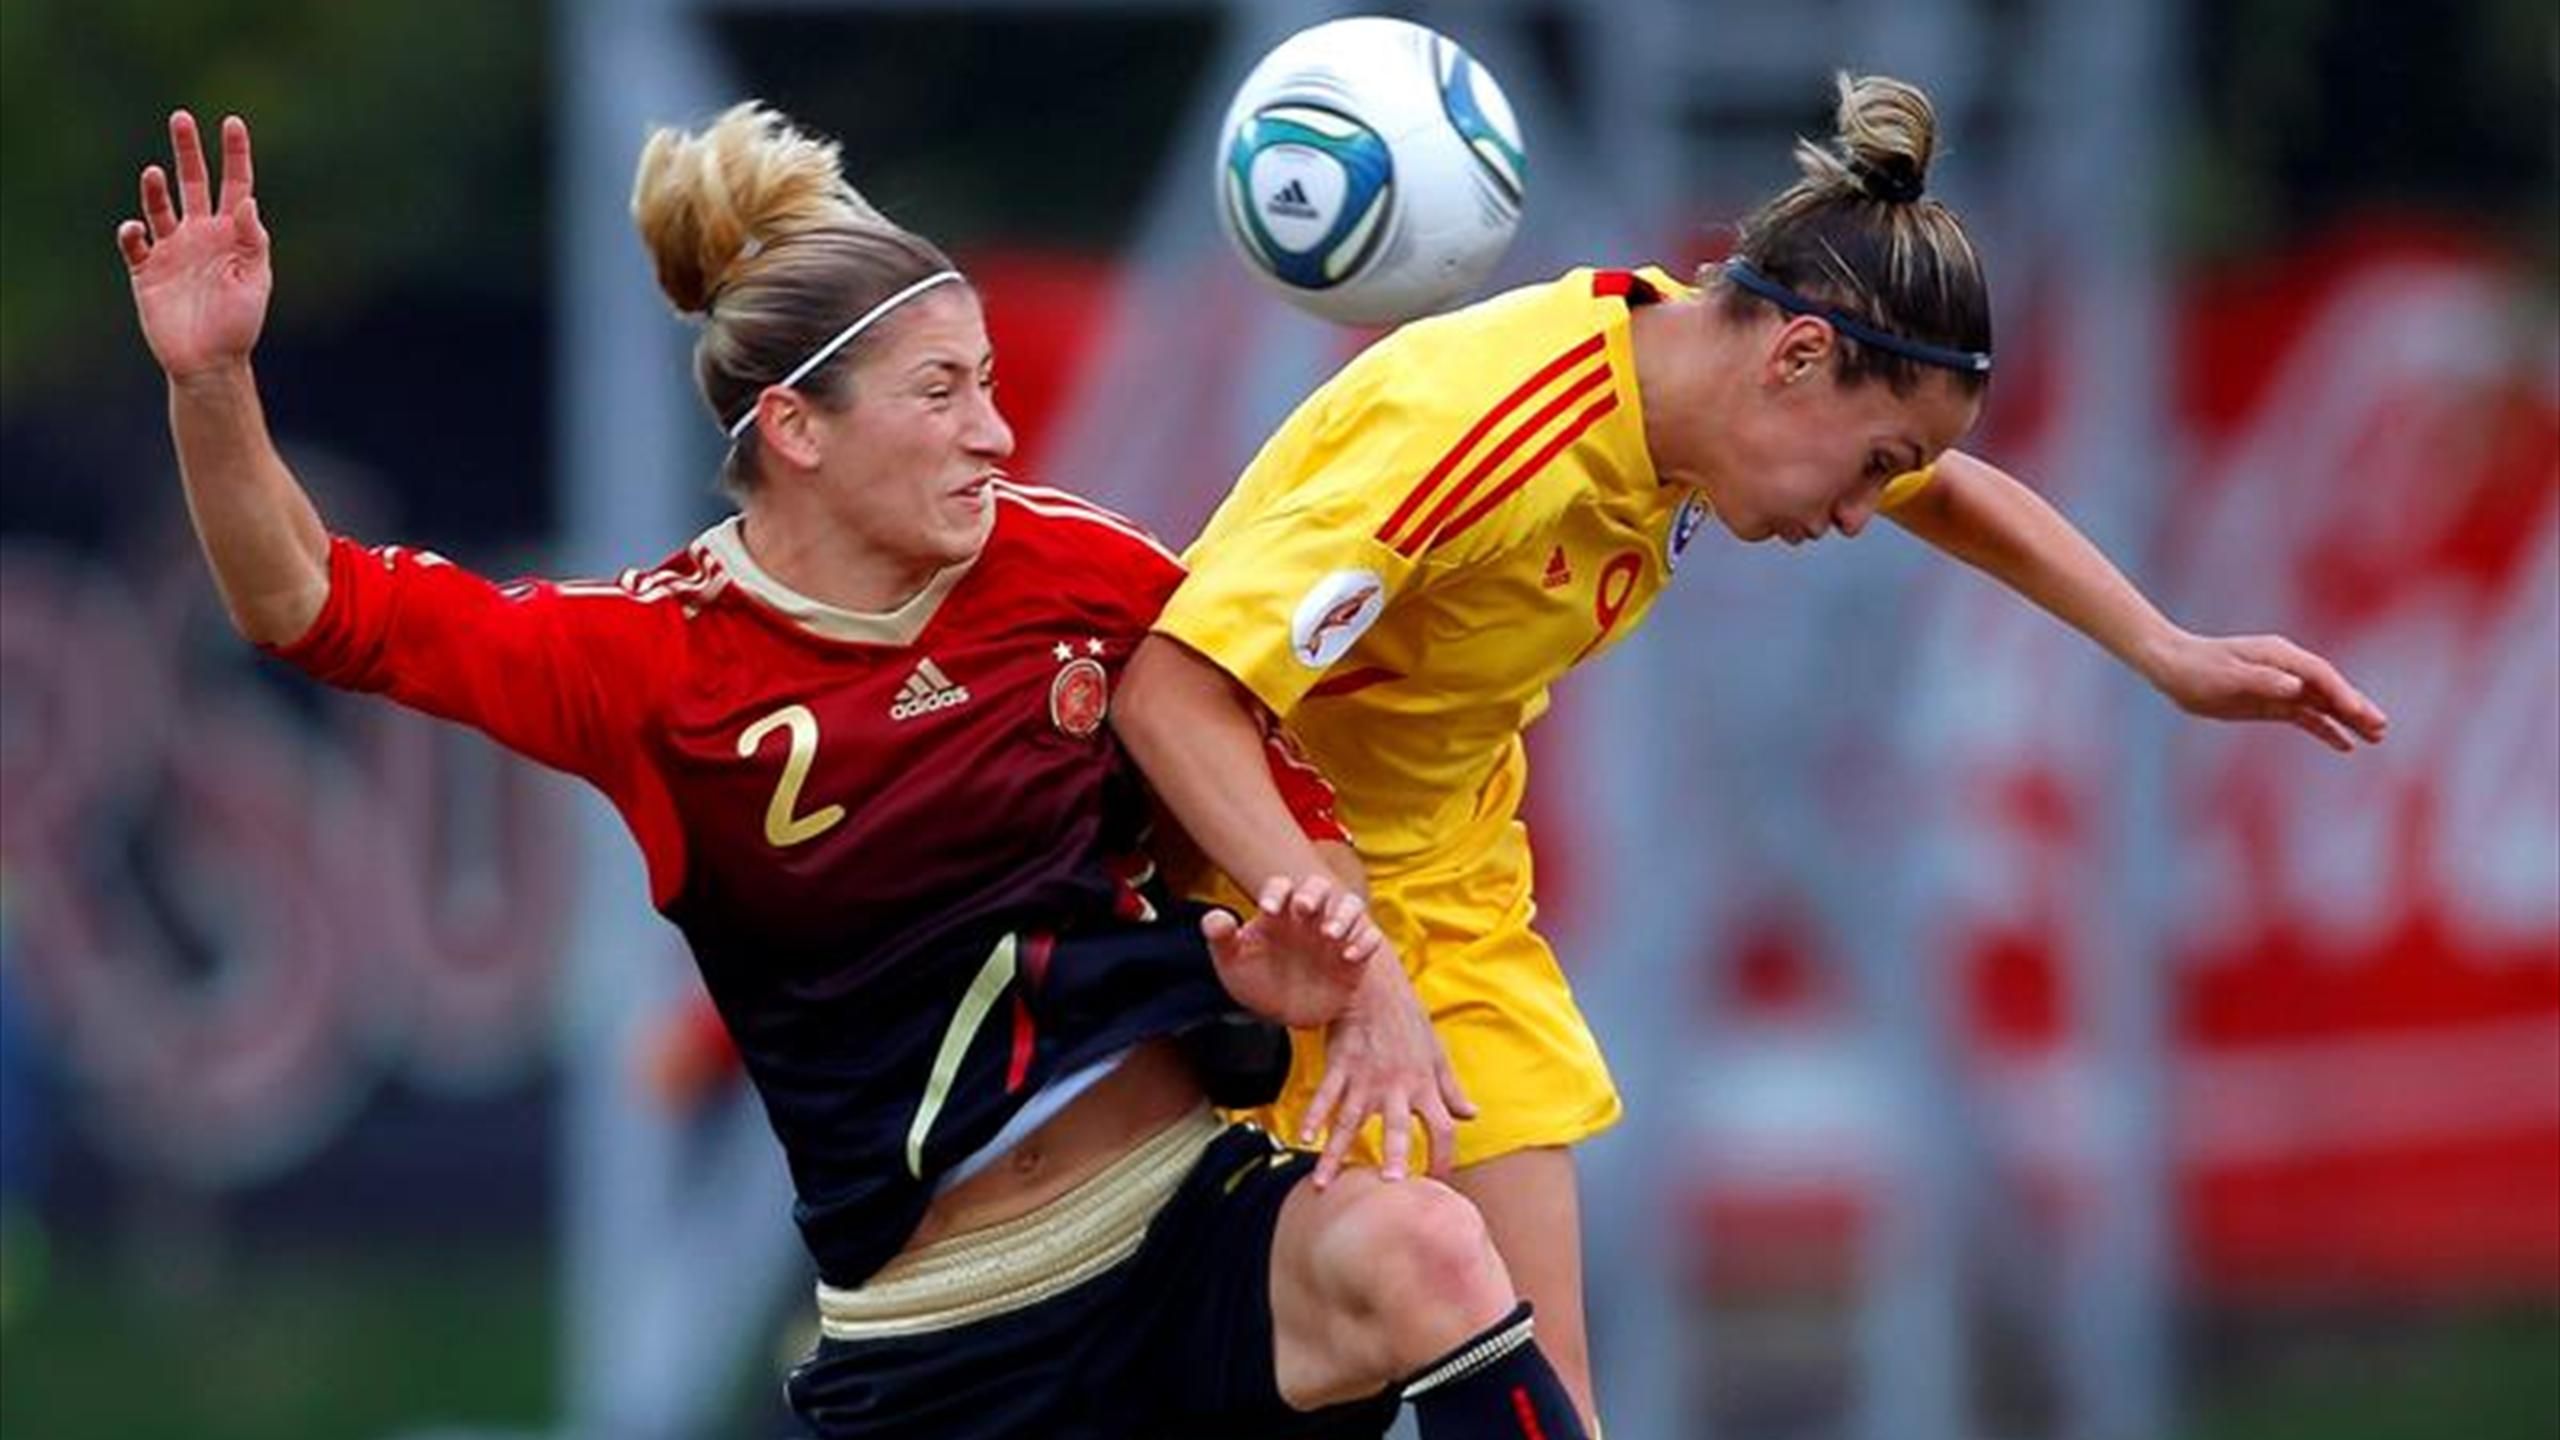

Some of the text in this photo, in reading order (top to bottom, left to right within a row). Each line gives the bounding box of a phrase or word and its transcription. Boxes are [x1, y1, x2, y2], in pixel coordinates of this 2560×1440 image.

[1572, 549, 1643, 664] 9
[890, 685, 970, 721] adidas
[736, 703, 846, 847] 2
